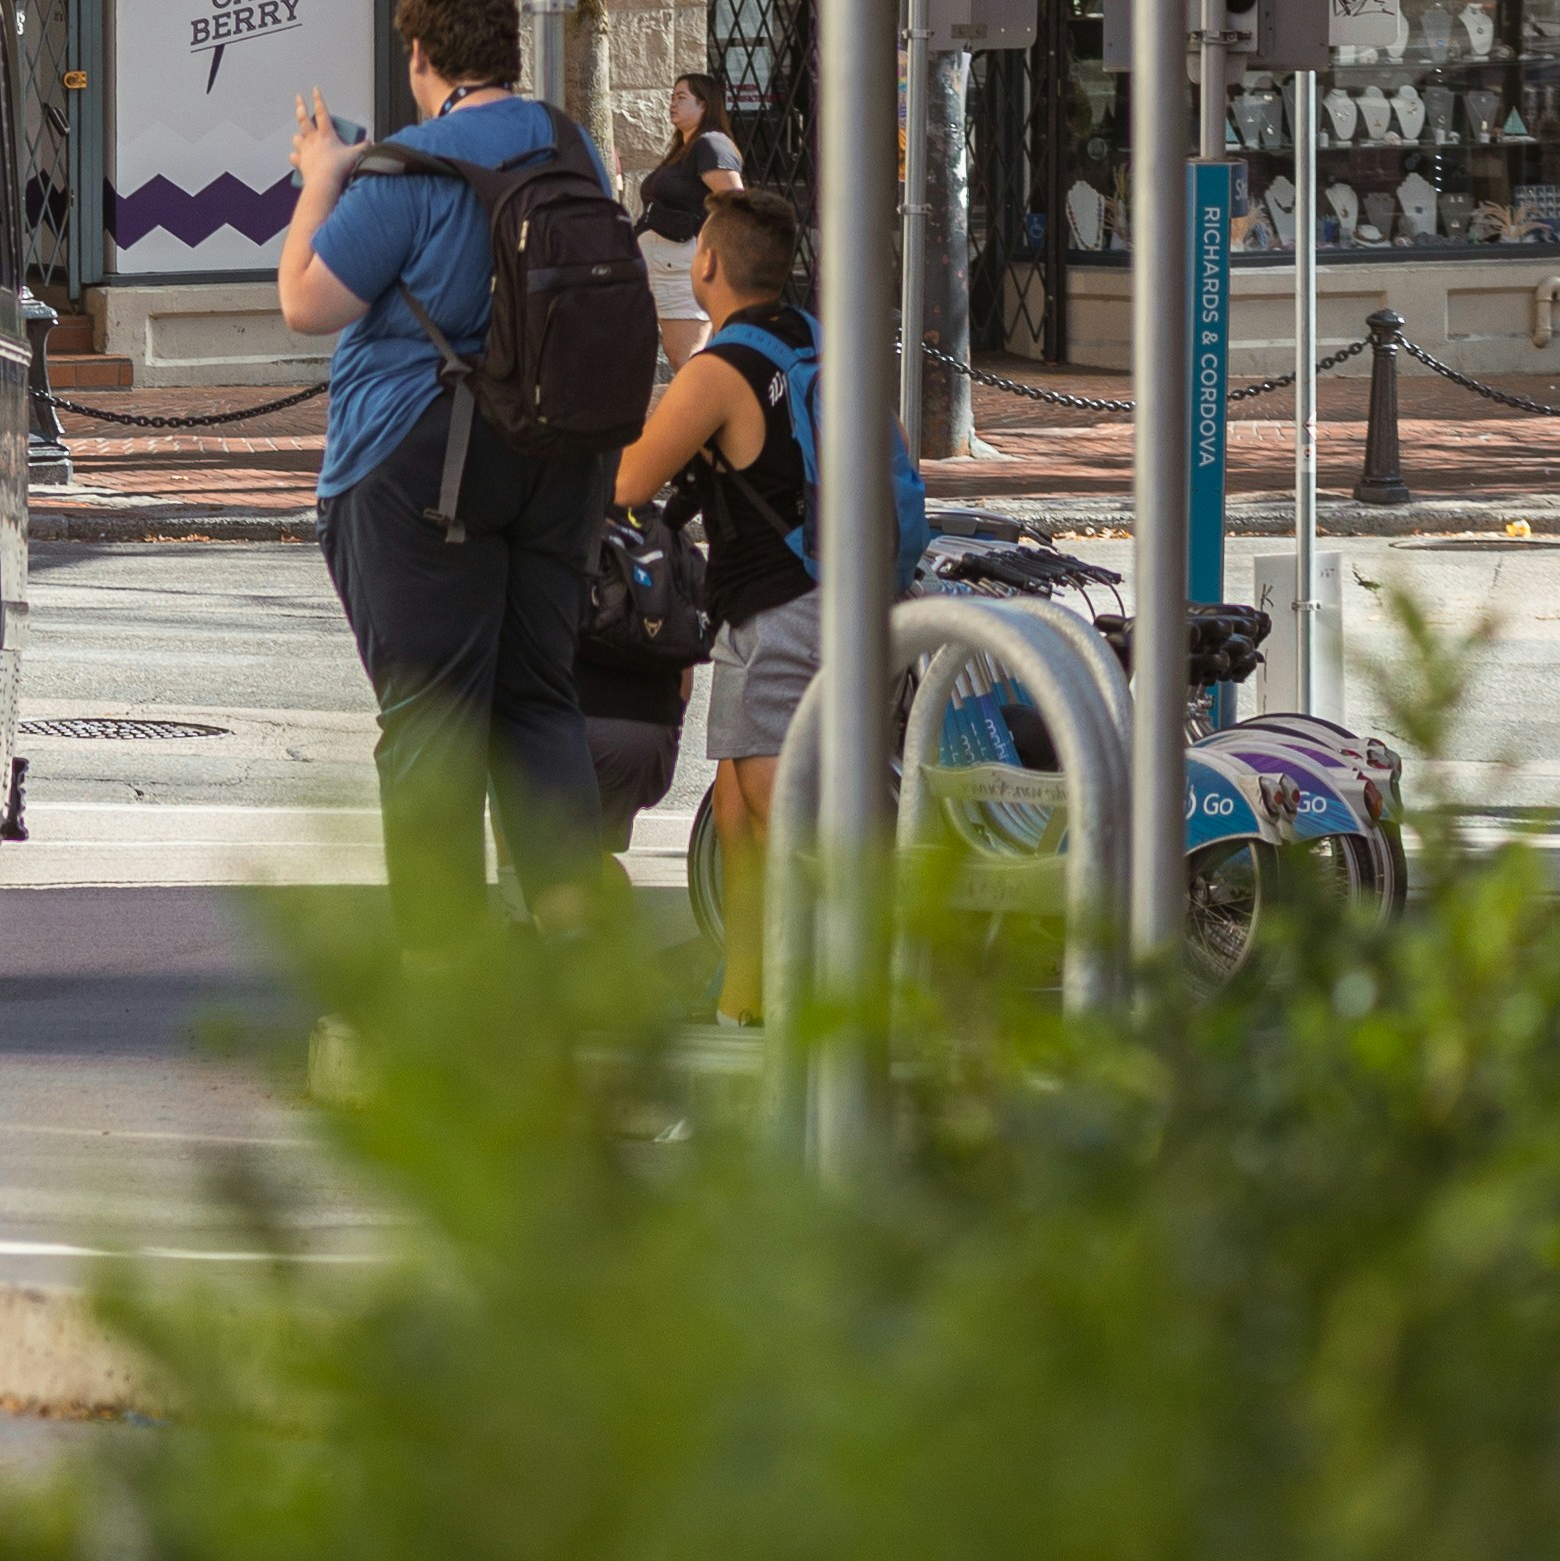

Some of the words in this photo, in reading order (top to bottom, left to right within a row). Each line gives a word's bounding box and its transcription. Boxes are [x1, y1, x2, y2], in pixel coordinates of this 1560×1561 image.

[1203, 206, 1221, 324] RICHARDS
[1201, 331, 1218, 345] &
[1198, 353, 1218, 468] CORDOVA
[1203, 792, 1234, 816] Go
[1297, 791, 1327, 814] Go
